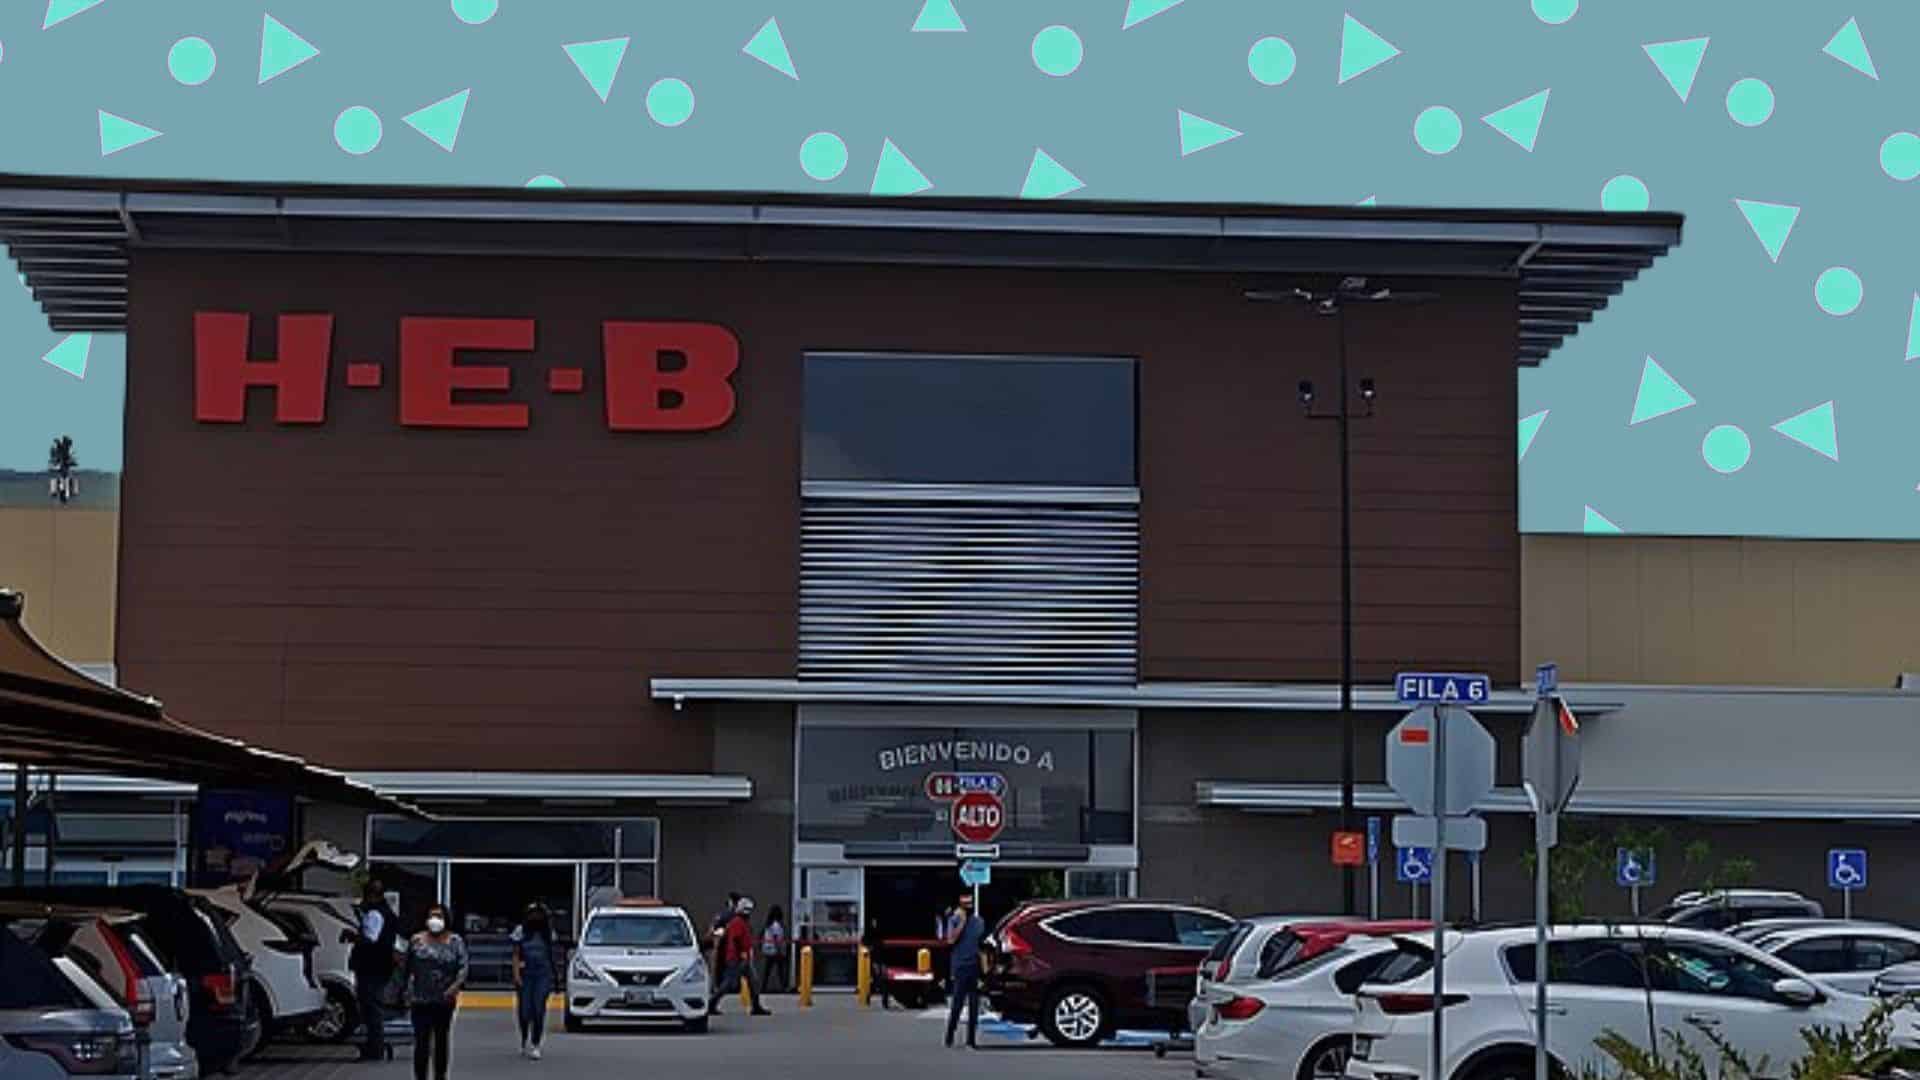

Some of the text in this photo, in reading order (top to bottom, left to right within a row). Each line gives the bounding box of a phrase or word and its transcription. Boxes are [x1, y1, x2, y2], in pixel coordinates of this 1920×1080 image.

[192, 309, 740, 432] H-E-B
[1402, 677, 1484, 699] FILA 6
[879, 741, 1054, 771] BIENVENIDO A
[957, 803, 1001, 828] ALTO
